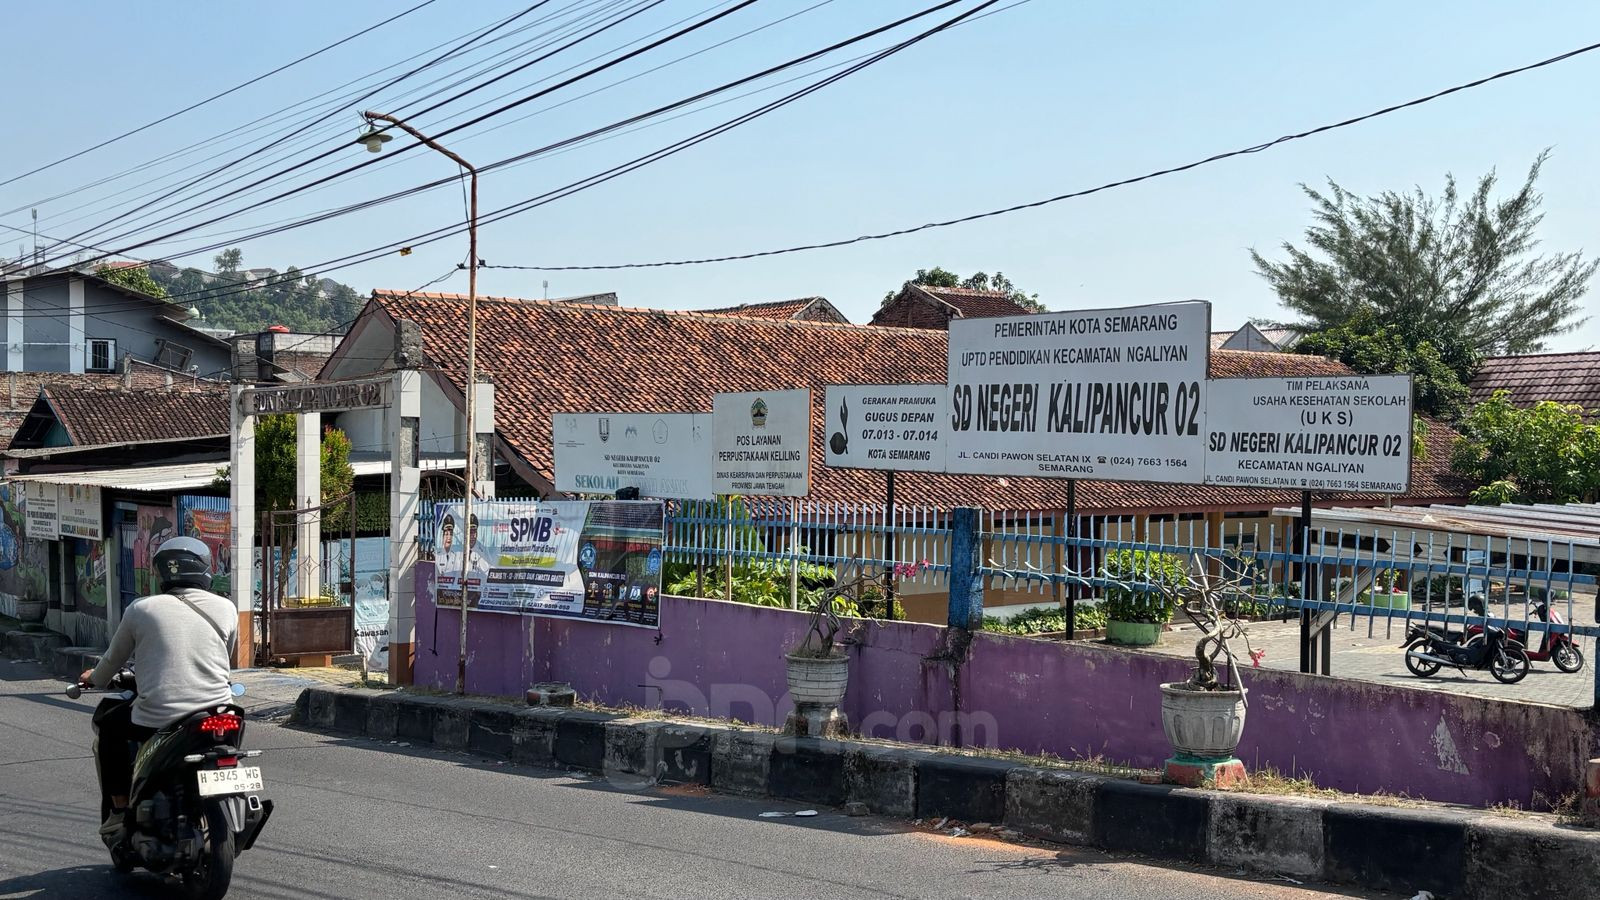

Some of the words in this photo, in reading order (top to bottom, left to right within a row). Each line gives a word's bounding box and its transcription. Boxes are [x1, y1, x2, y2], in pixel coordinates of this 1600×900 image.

[994, 319, 1066, 338] PEMERINTAH
[1069, 317, 1101, 335] KOTA
[1104, 314, 1178, 333] SEMARANG
[961, 351, 987, 367] UPTD
[989, 349, 1050, 367] PENDIDIKAN
[1053, 346, 1121, 364] KECAMATAN
[1127, 345, 1188, 363] NGALIYAN
[1286, 381, 1303, 391] TIM
[1305, 380, 1370, 391] PELAKSANA
[862, 397, 897, 405] GERAKAN
[899, 397, 936, 405] PRAMUKA
[1253, 396, 1287, 406] USAHA
[1290, 395, 1350, 406] KESEHATAN
[1353, 395, 1406, 406] SEKOLAH
[951, 383, 972, 432] SD
[976, 383, 1039, 432] NEGERI
[1047, 382, 1168, 436] KALIPANCUR
[1174, 381, 1200, 437] 02
[865, 412, 898, 423] GUGUS
[901, 413, 935, 423] DEPAN
[736, 435, 750, 446] POS
[751, 435, 782, 446] LAYANAN
[862, 429, 894, 440] 07.013
[903, 430, 938, 441] 07.014
[1209, 431, 1227, 452] SD
[1230, 432, 1281, 454] NEGERI
[1284, 432, 1378, 457] KALIPANCUR
[1383, 434, 1401, 457] 02
[719, 451, 769, 462] PERPUSTAKAAN
[770, 450, 801, 461] KELILING
[868, 449, 887, 459] KOTA
[888, 450, 931, 461] SEMARANG
[958, 451, 970, 459] JL.
[973, 451, 1000, 460] CANDI
[1001, 452, 1034, 462] PAWON
[1036, 453, 1080, 464] SELATAN
[1082, 455, 1091, 464] IX
[1110, 456, 1135, 467] (024)
[1137, 457, 1162, 467] 7663
[1165, 458, 1188, 468] 1564
[1038, 463, 1094, 474] SEMARANG
[1238, 459, 1303, 471] KECAMATAN
[1306, 462, 1365, 474] NGALIYAN
[575, 475, 619, 490] SEKOLAH
[1215, 475, 1234, 484] CANDI
[1235, 476, 1259, 484] PAWON
[1260, 477, 1289, 486] SELATAN
[1360, 480, 1402, 491] SEMARANG
[510, 517, 552, 542] SPMB
[354, 628, 389, 638] Kawasan
[200, 773, 207, 783] H
[213, 770, 238, 782] 3945
[245, 769, 259, 779] WG
